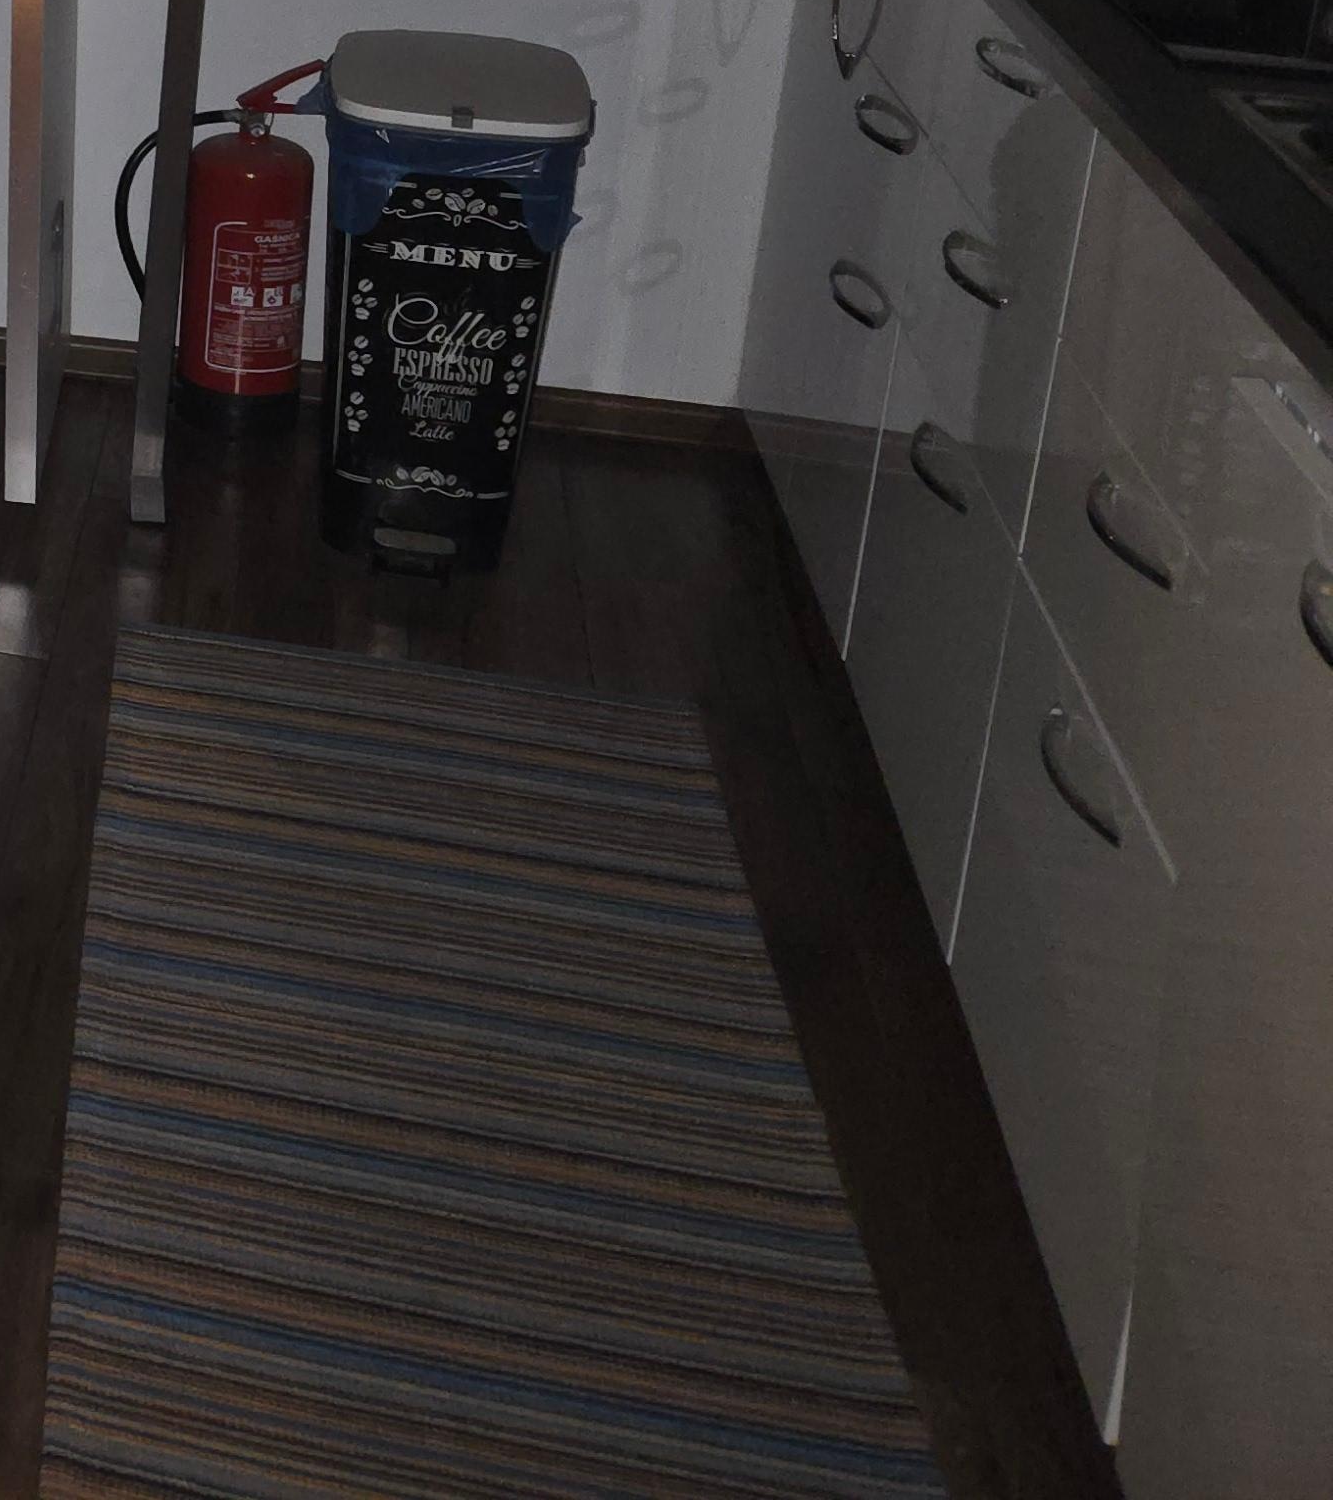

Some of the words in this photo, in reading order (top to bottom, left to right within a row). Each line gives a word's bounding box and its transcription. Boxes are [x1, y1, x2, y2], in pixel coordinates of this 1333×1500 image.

[390, 240, 518, 272] MENU
[387, 293, 508, 365] Coffee
[393, 347, 494, 386] ESPRESSO
[401, 393, 472, 423] AMERICANO
[409, 420, 455, 441] Latte
